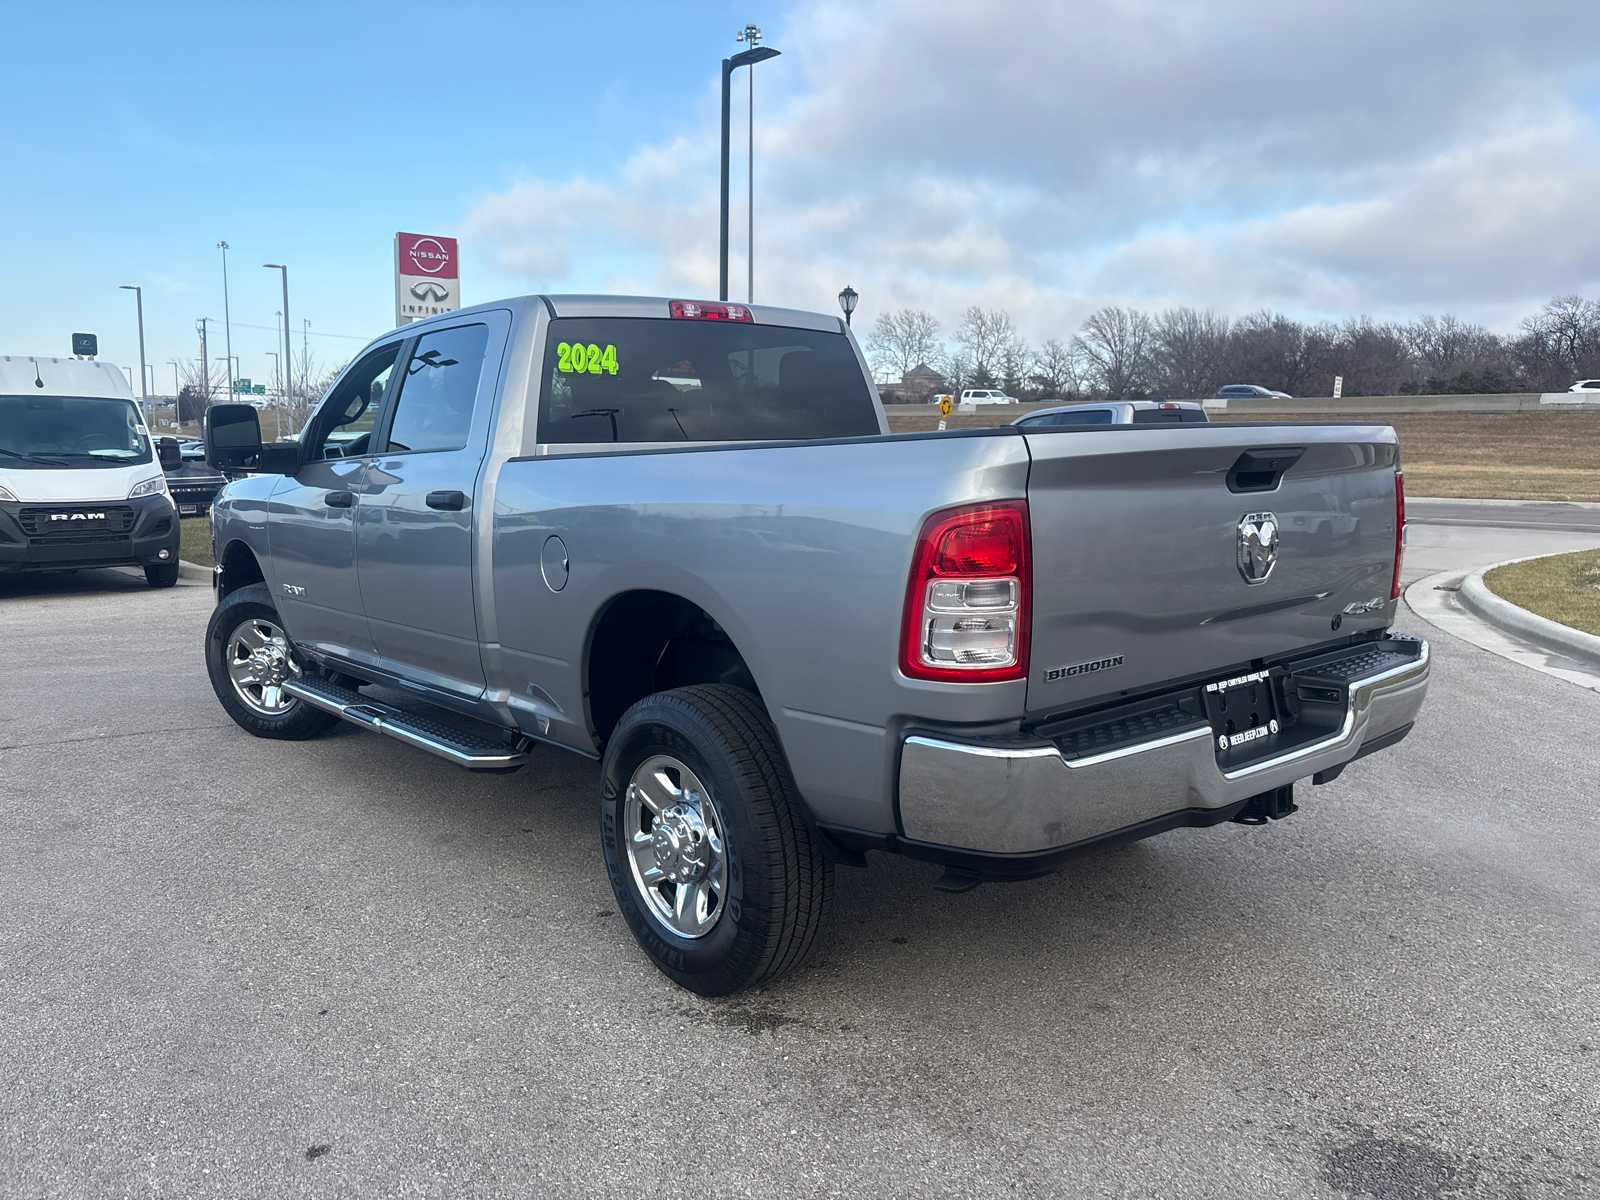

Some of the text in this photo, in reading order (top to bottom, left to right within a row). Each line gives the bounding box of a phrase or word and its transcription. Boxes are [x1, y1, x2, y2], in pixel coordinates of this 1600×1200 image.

[409, 250, 449, 260] NISSAN
[403, 304, 456, 314] INFINIT
[557, 342, 619, 375] 2024
[51, 513, 105, 521] RAM
[282, 583, 307, 597] RAM
[1045, 654, 1124, 682] BIGHORN
[1230, 726, 1268, 746] REEDJEEP.COM
